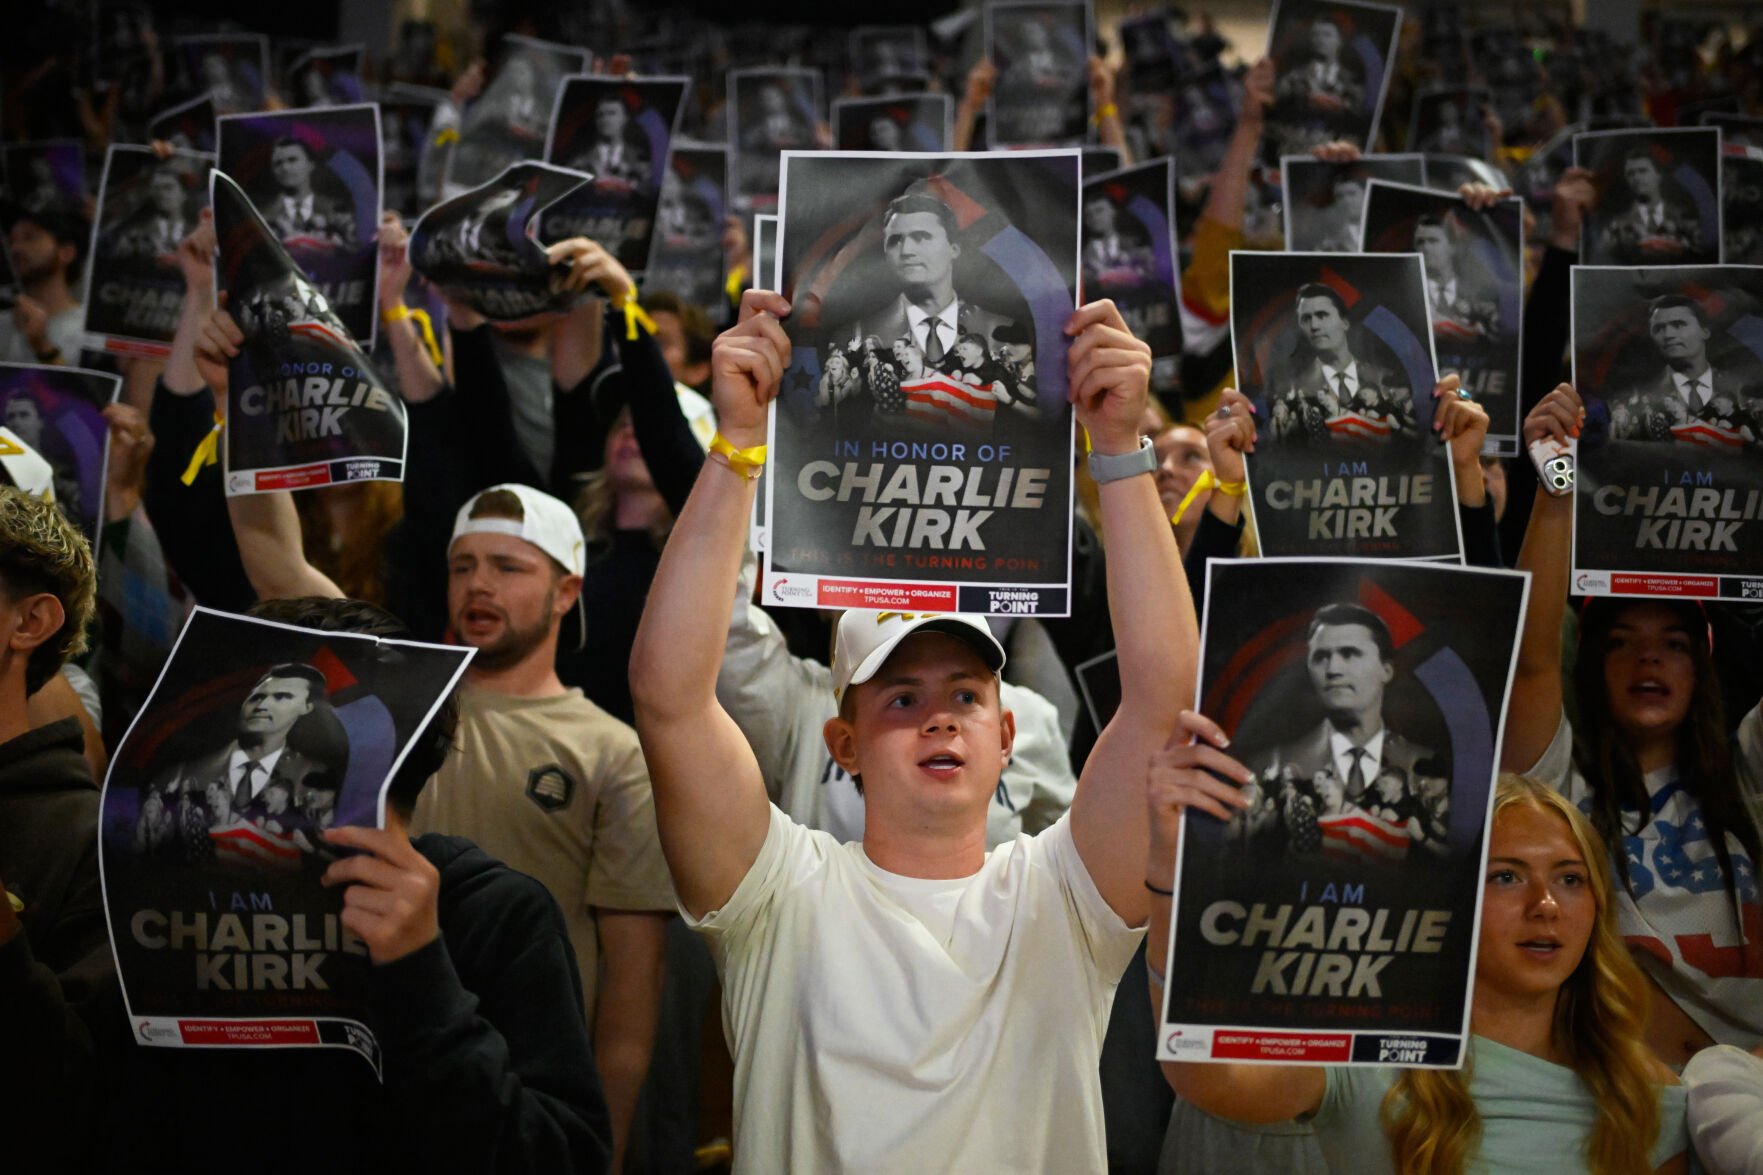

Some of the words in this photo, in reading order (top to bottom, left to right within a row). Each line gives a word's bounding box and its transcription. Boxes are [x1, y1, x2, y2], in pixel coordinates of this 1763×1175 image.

[239, 376, 389, 417] CHARLIE
[276, 405, 352, 444] KIRK
[834, 440, 860, 457] IN
[871, 441, 966, 461] HONOR
[977, 444, 1012, 462] OF
[345, 462, 381, 470] TURNING
[346, 468, 380, 479] POINT
[1323, 463, 1329, 476] I
[1338, 460, 1368, 476] AM
[797, 460, 1051, 509] CHARLIE
[1663, 469, 1670, 486] I
[1680, 471, 1713, 487] AM
[1264, 474, 1434, 510] CHARLIE
[1593, 484, 1763, 521] CHARLI
[851, 505, 995, 550] KIRK
[1308, 506, 1400, 541] KIRK
[1634, 517, 1744, 552] KIRK
[903, 554, 987, 570] TURNING
[822, 585, 858, 594] IDENTIFY
[864, 587, 904, 597] EMPOWER
[910, 589, 952, 599] ORGANIZE
[864, 595, 910, 605] TPUSA.COM
[988, 590, 1039, 601] TURNING
[989, 600, 1039, 614] POINT
[207, 889, 217, 912] I
[230, 890, 273, 912] AM
[1300, 880, 1309, 904] I
[1320, 881, 1365, 905] AM
[1200, 899, 1453, 954] CHARLIE
[195, 951, 332, 991] KIRK
[1249, 950, 1396, 998] KIRK
[1378, 1038, 1428, 1050] TURNING
[1378, 1049, 1428, 1063] POINT
